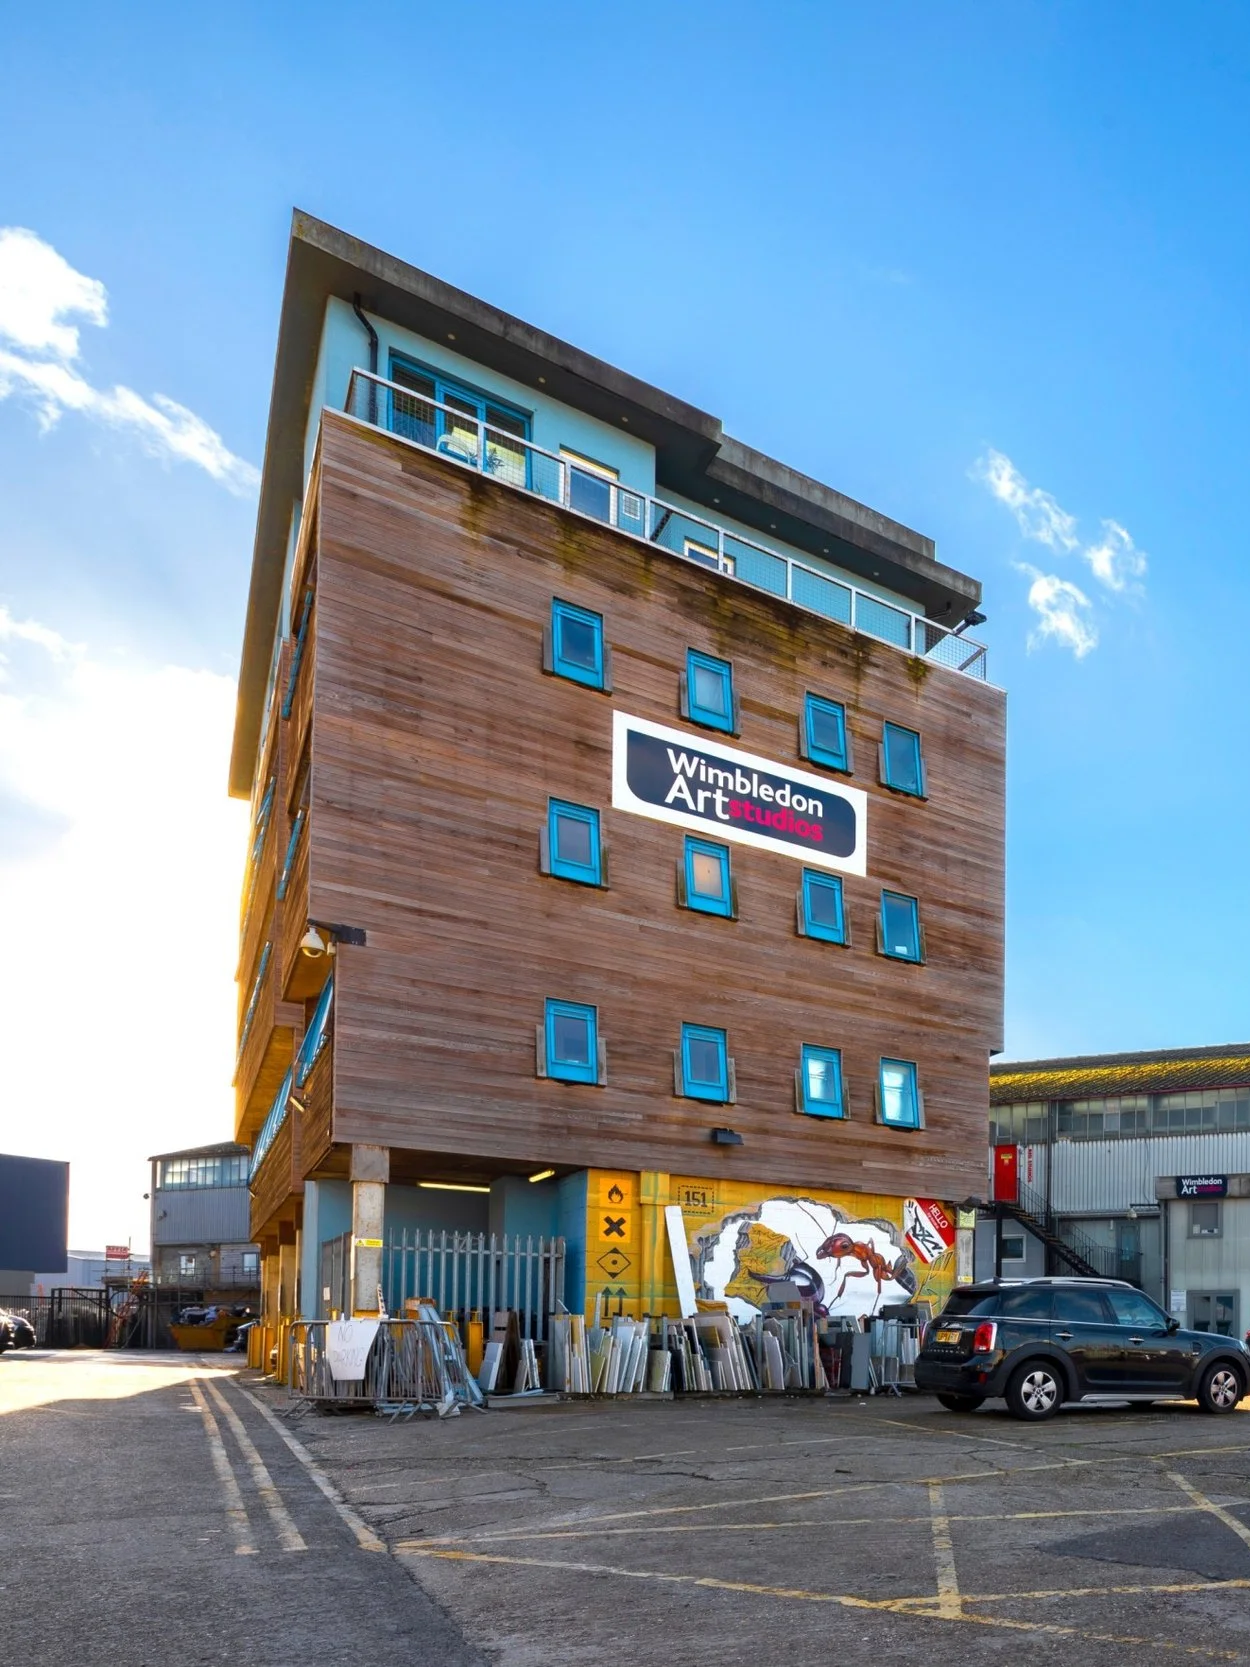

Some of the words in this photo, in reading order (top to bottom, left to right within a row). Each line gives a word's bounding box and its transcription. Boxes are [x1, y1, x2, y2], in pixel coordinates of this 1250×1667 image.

[667, 748, 823, 818] Wimbledon
[1181, 1177, 1222, 1186] Wimbledon
[684, 1190, 708, 1208] 151
[928, 1203, 948, 1229] HELLO
[337, 1325, 353, 1343] NO
